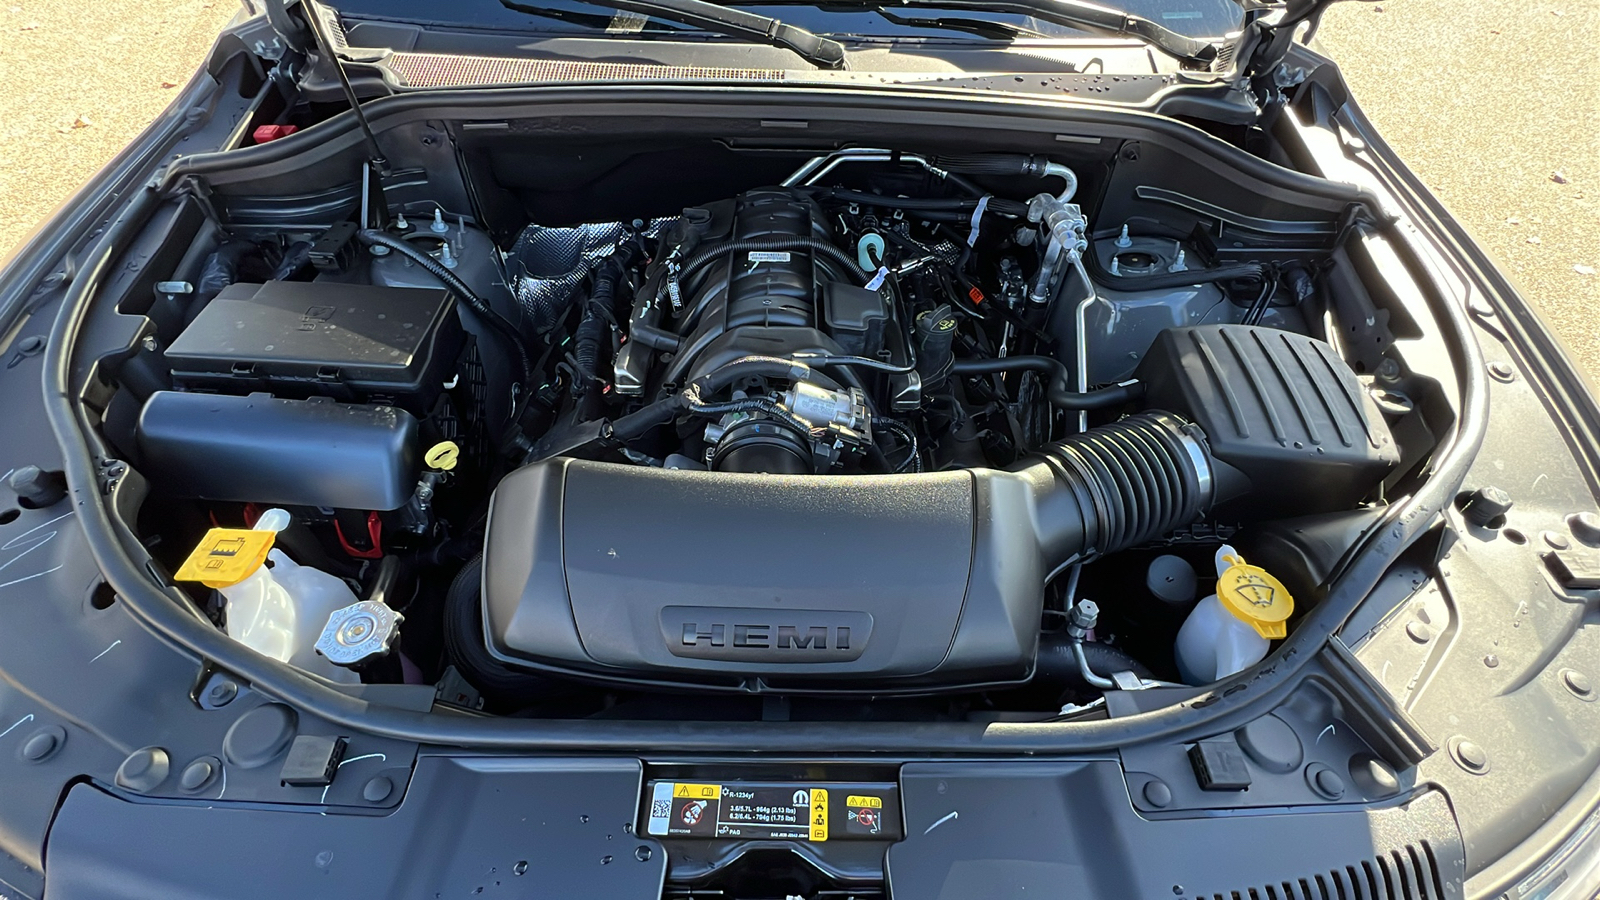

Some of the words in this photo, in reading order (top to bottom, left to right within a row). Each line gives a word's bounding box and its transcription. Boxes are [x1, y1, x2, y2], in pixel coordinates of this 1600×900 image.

[682, 623, 850, 650] HEMI
[729, 792, 754, 800] R-1234yf
[771, 806, 785, 814] (2.13
[771, 814, 785, 822] (1.75
